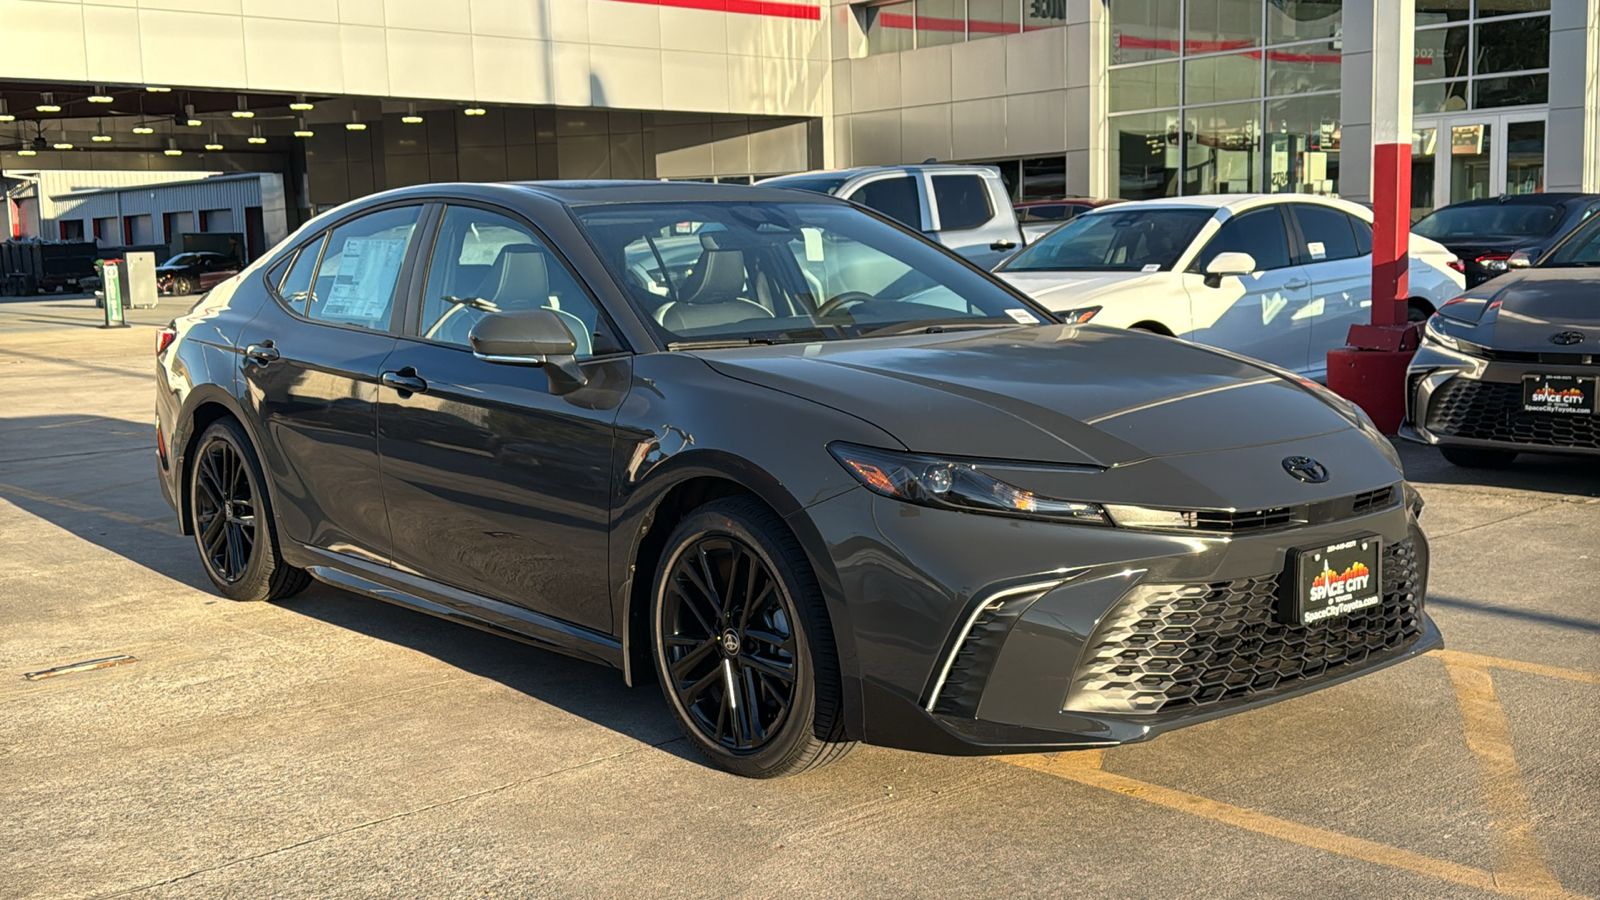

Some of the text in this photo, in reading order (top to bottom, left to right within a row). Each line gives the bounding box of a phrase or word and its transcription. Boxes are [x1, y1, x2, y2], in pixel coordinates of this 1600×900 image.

[1532, 390, 1584, 404] SPACE CITY
[1524, 404, 1591, 414] SpaceCityToyota.com
[1309, 573, 1369, 601] SPACE CITY
[1304, 595, 1379, 623] SpaceCityToyota.com
